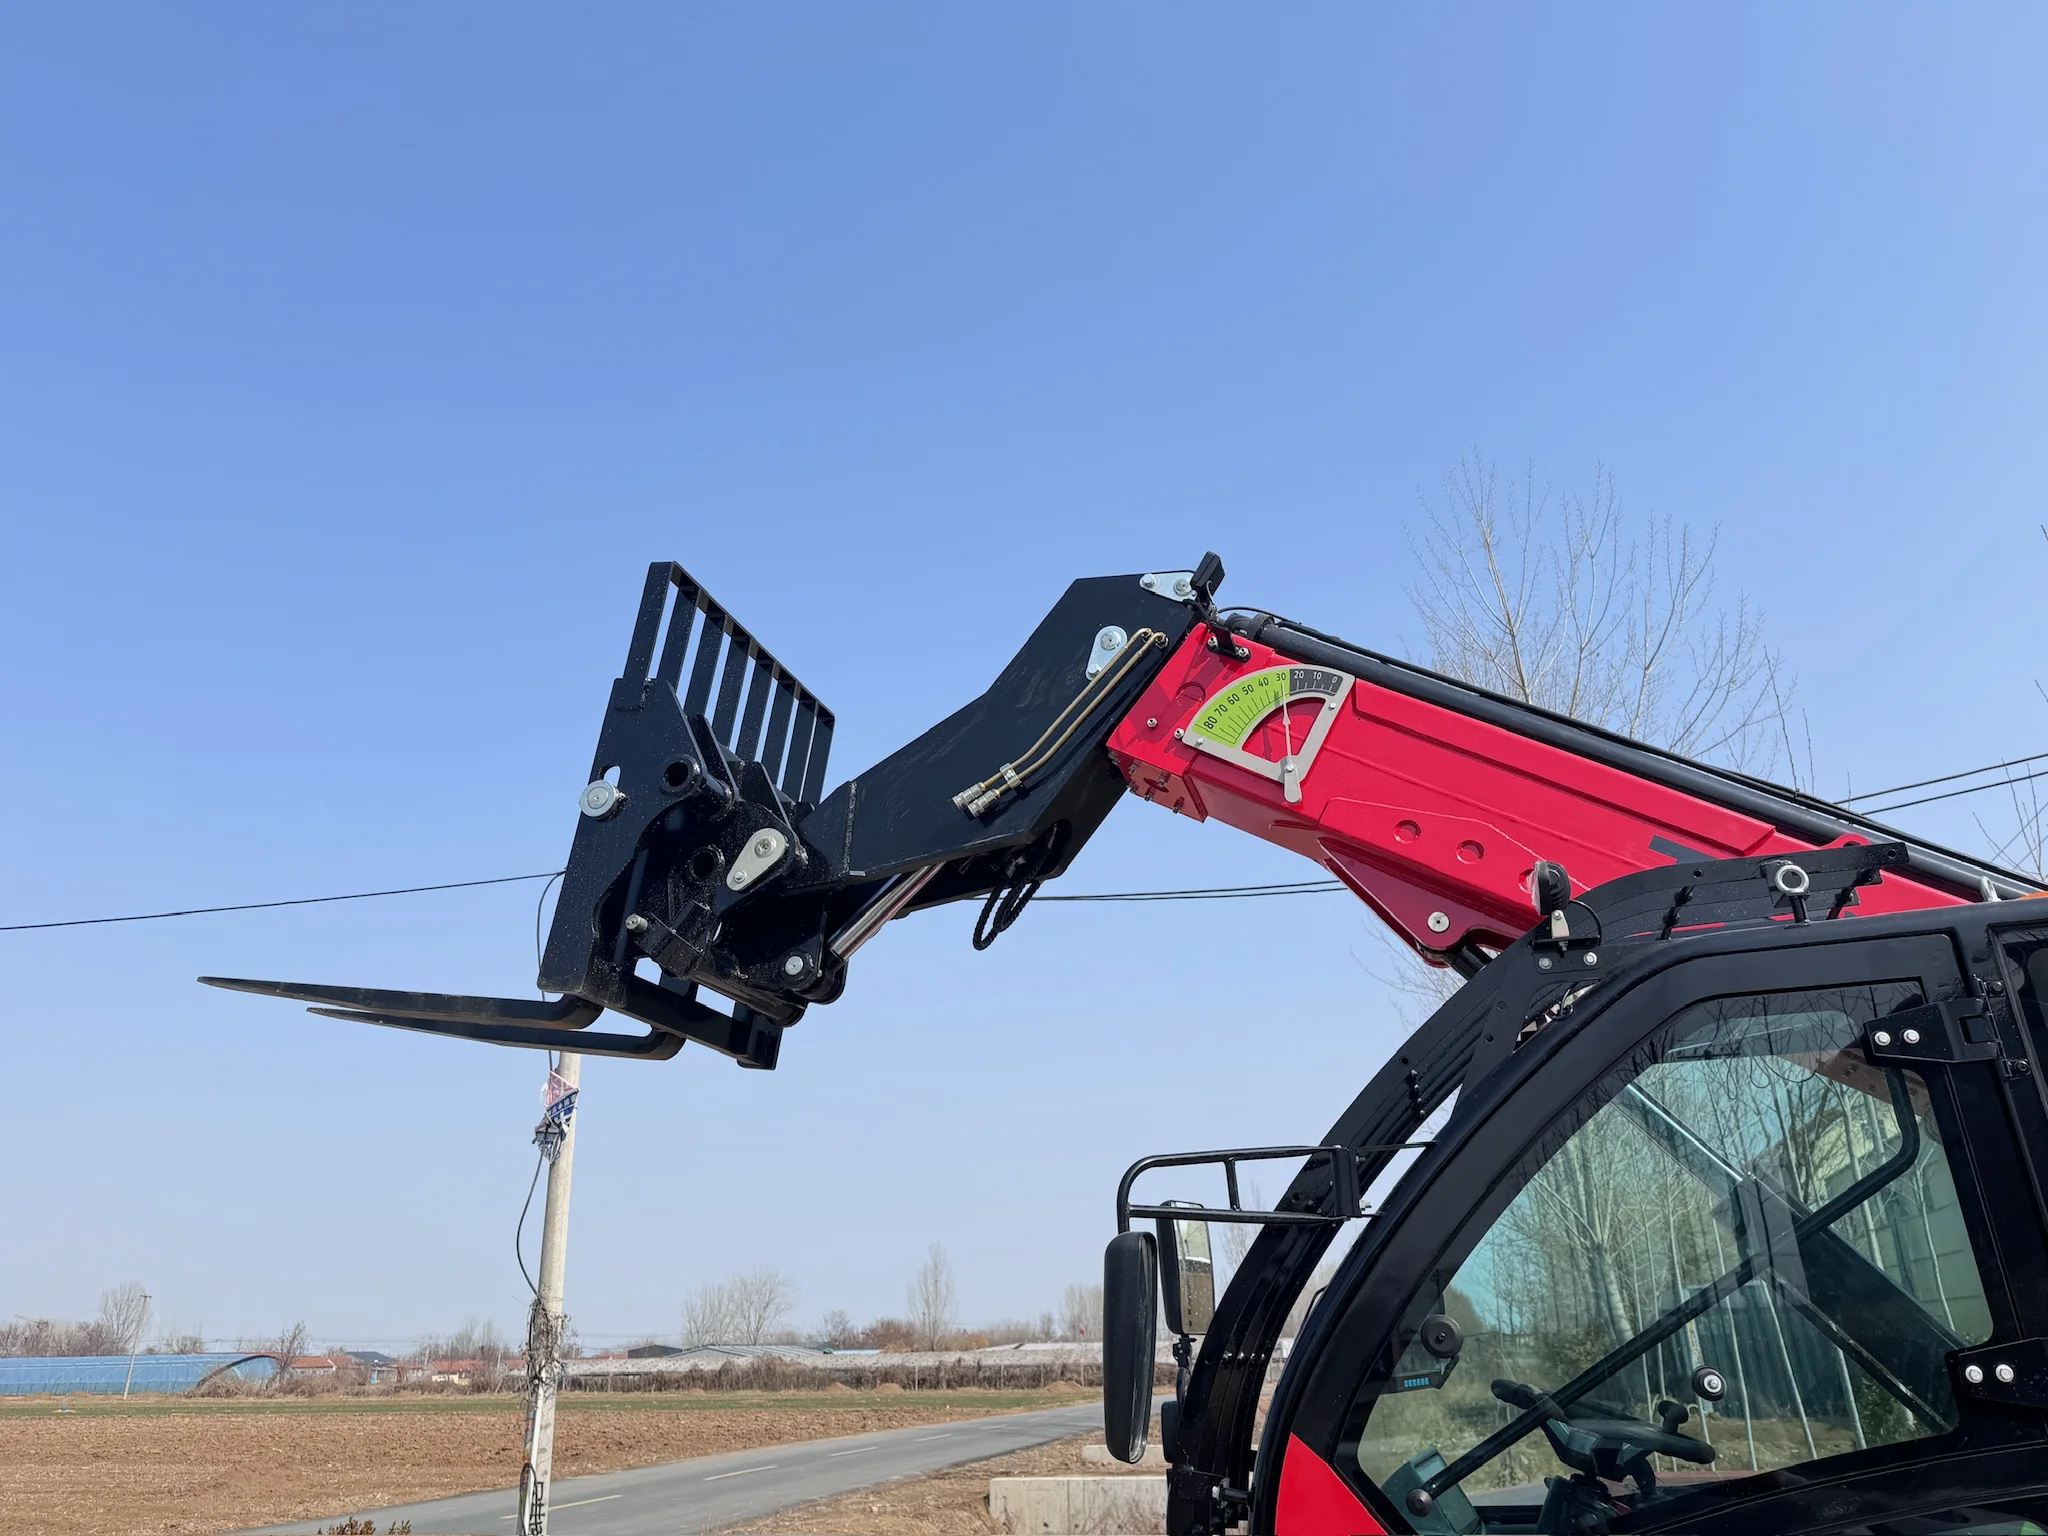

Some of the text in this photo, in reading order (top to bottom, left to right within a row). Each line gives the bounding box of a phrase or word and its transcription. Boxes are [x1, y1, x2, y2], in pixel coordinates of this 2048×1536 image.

[1203, 670, 1338, 730] 80 70 60 50 40 30 20 10 0
